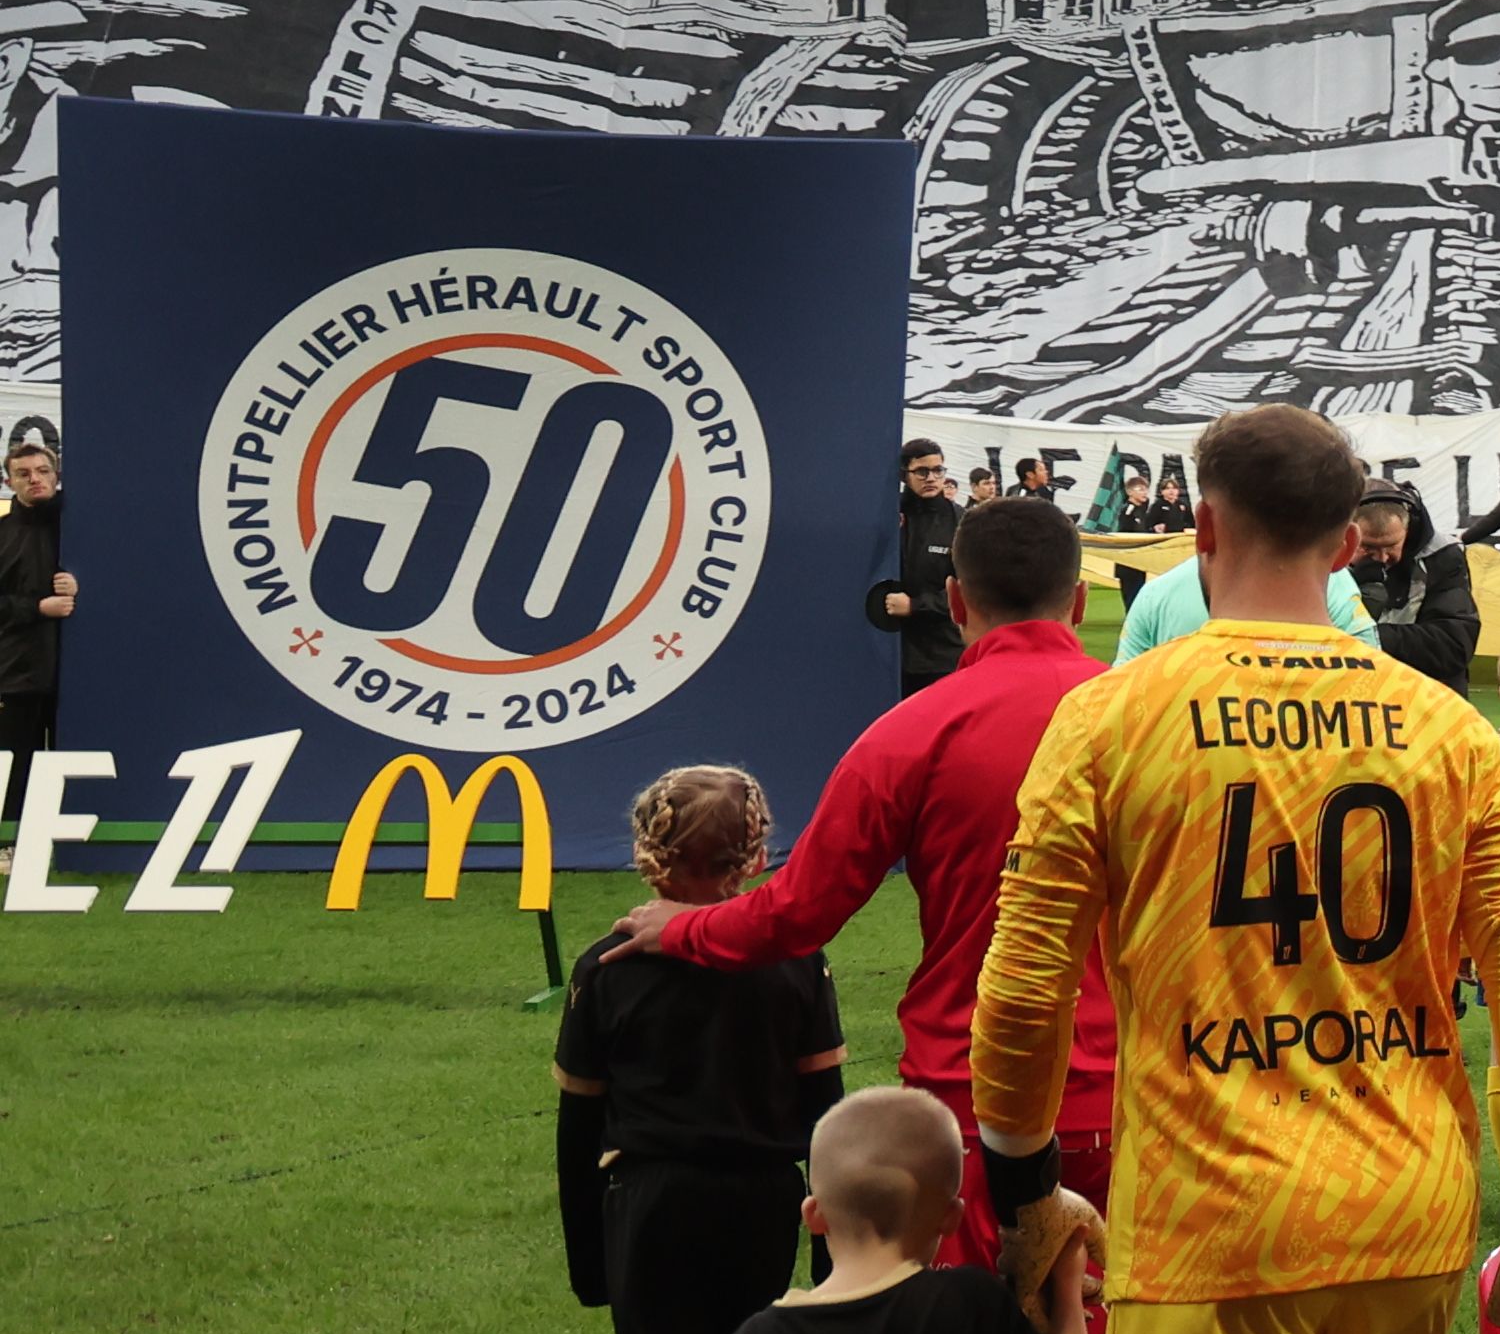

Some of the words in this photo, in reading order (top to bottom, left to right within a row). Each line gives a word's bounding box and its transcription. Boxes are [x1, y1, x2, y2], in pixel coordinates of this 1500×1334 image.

[387, 268, 647, 343] HÉRAULT
[642, 336, 748, 480] SPORT
[227, 303, 388, 616] MONTPELLIER
[309, 356, 674, 657] 50
[681, 495, 748, 620] CLUB
[331, 656, 451, 726] 1974
[502, 663, 636, 730] 2024
[1258, 655, 1376, 671] FAUN
[1189, 696, 1408, 751] LECOMTE
[1209, 782, 1413, 967] 40
[1181, 1005, 1450, 1076] KAPORAL
